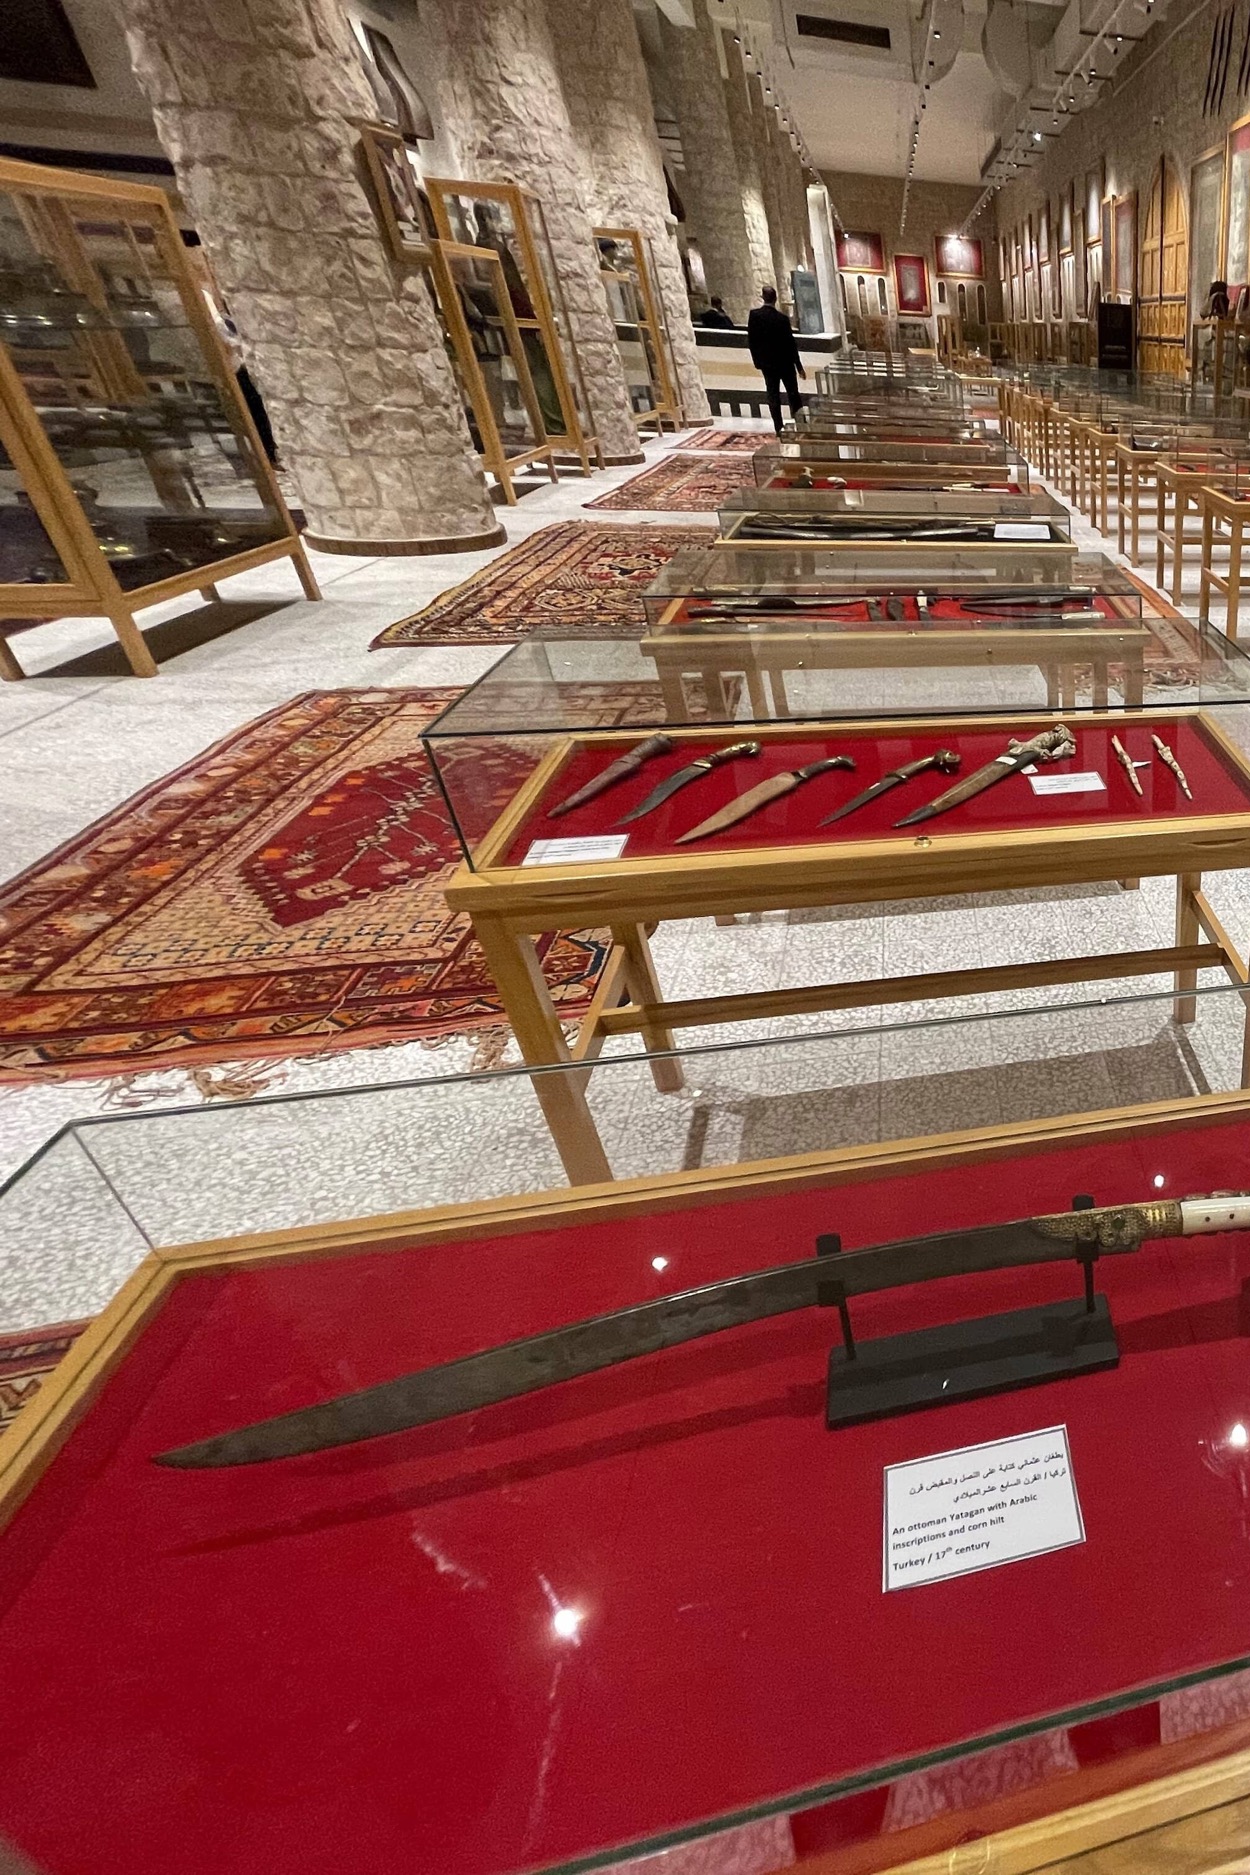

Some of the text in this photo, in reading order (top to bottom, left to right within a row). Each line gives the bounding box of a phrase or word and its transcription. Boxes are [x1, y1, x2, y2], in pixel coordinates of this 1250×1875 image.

[998, 1462, 1016, 1473] كتابة
[1017, 1456, 1041, 1471] عثماني
[959, 1471, 981, 1483] النصل
[982, 1467, 996, 1480] على
[1023, 1473, 1042, 1486] القرن
[1049, 1467, 1067, 1479] تركيا
[909, 1483, 924, 1496] قرن
[925, 1477, 958, 1492] والمقبض
[999, 1478, 1022, 1493] السابع
[892, 1493, 1038, 1536] An ottoman Yatagan with Arabic
[892, 1516, 1005, 1551] inscriptions and corn hilt
[892, 1557, 926, 1571] Turkey
[954, 1540, 991, 1555] century
